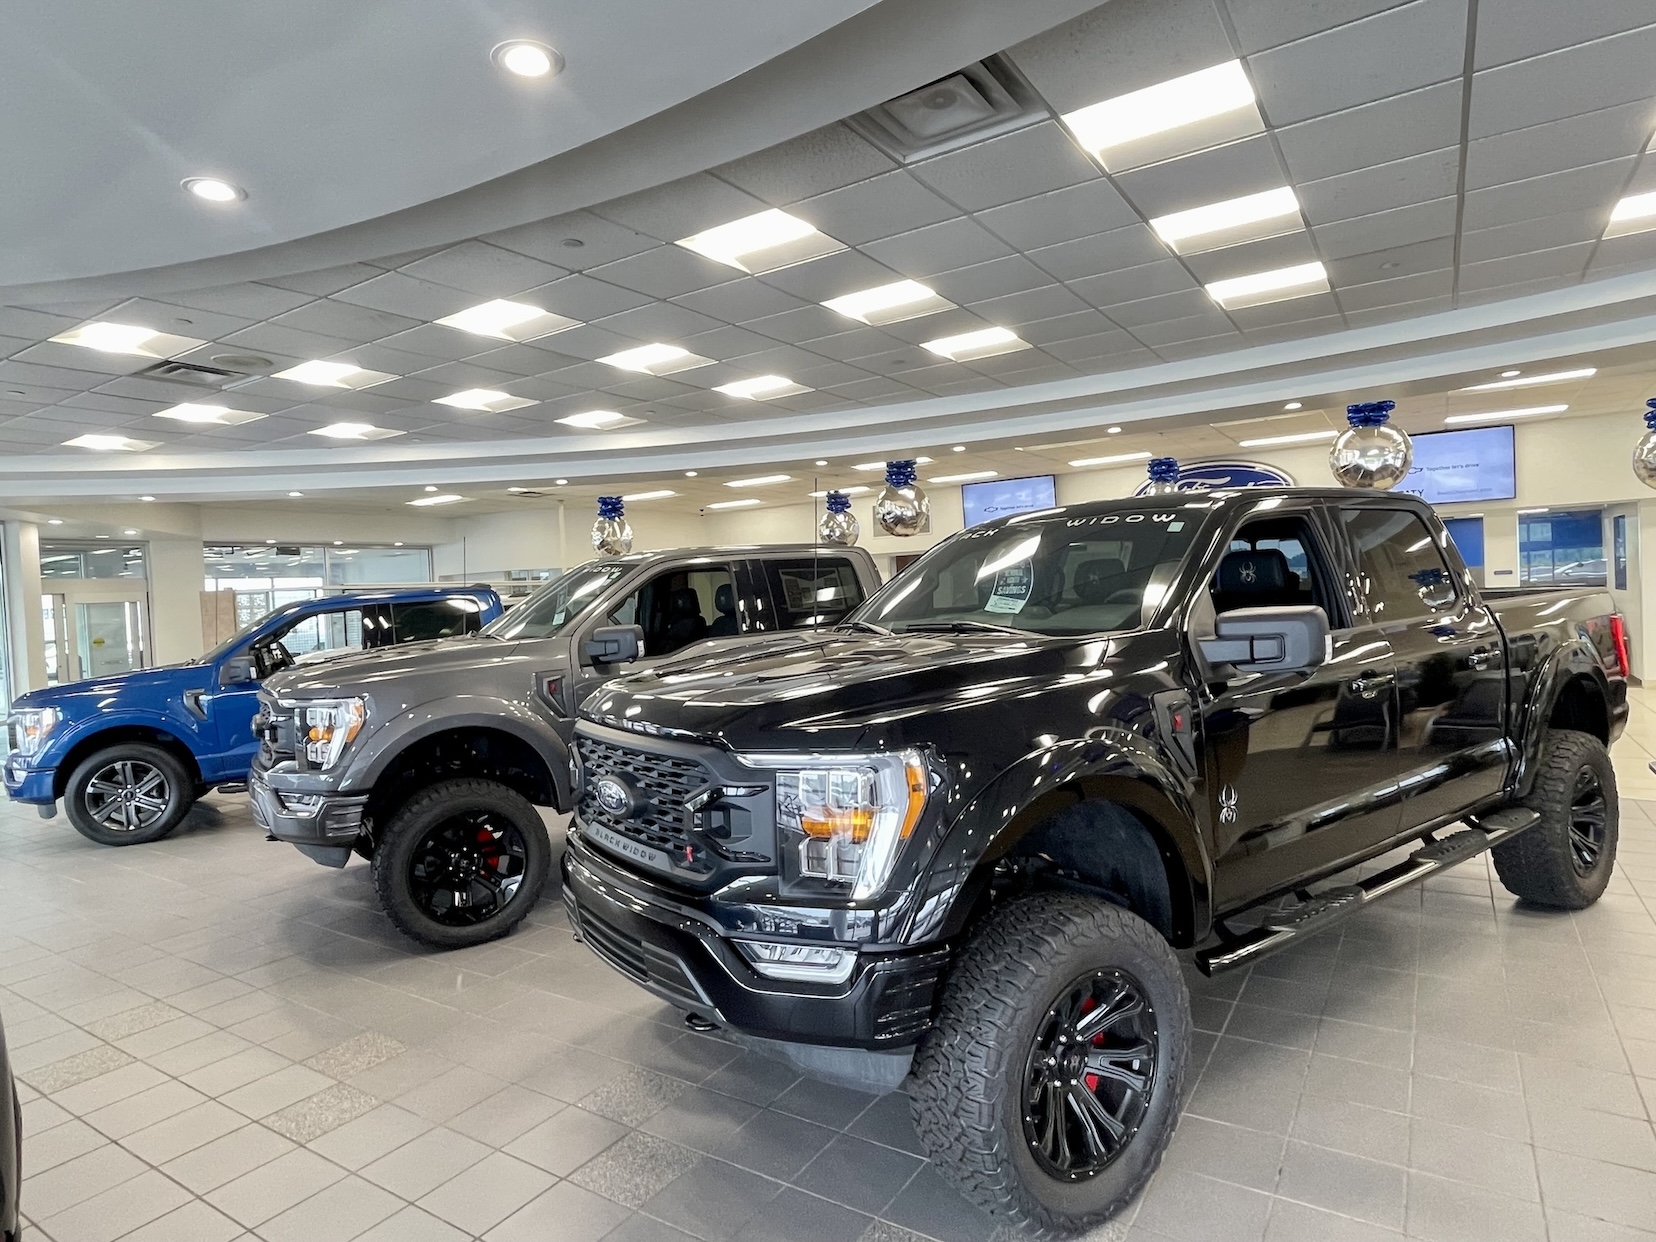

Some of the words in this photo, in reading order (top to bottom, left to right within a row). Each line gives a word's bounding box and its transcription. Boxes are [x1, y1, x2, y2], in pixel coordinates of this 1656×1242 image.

[959, 529, 999, 540] ACK
[1067, 514, 1176, 527] WIDOW
[595, 828, 621, 847] BLACK
[622, 842, 657, 862] WIDOW
